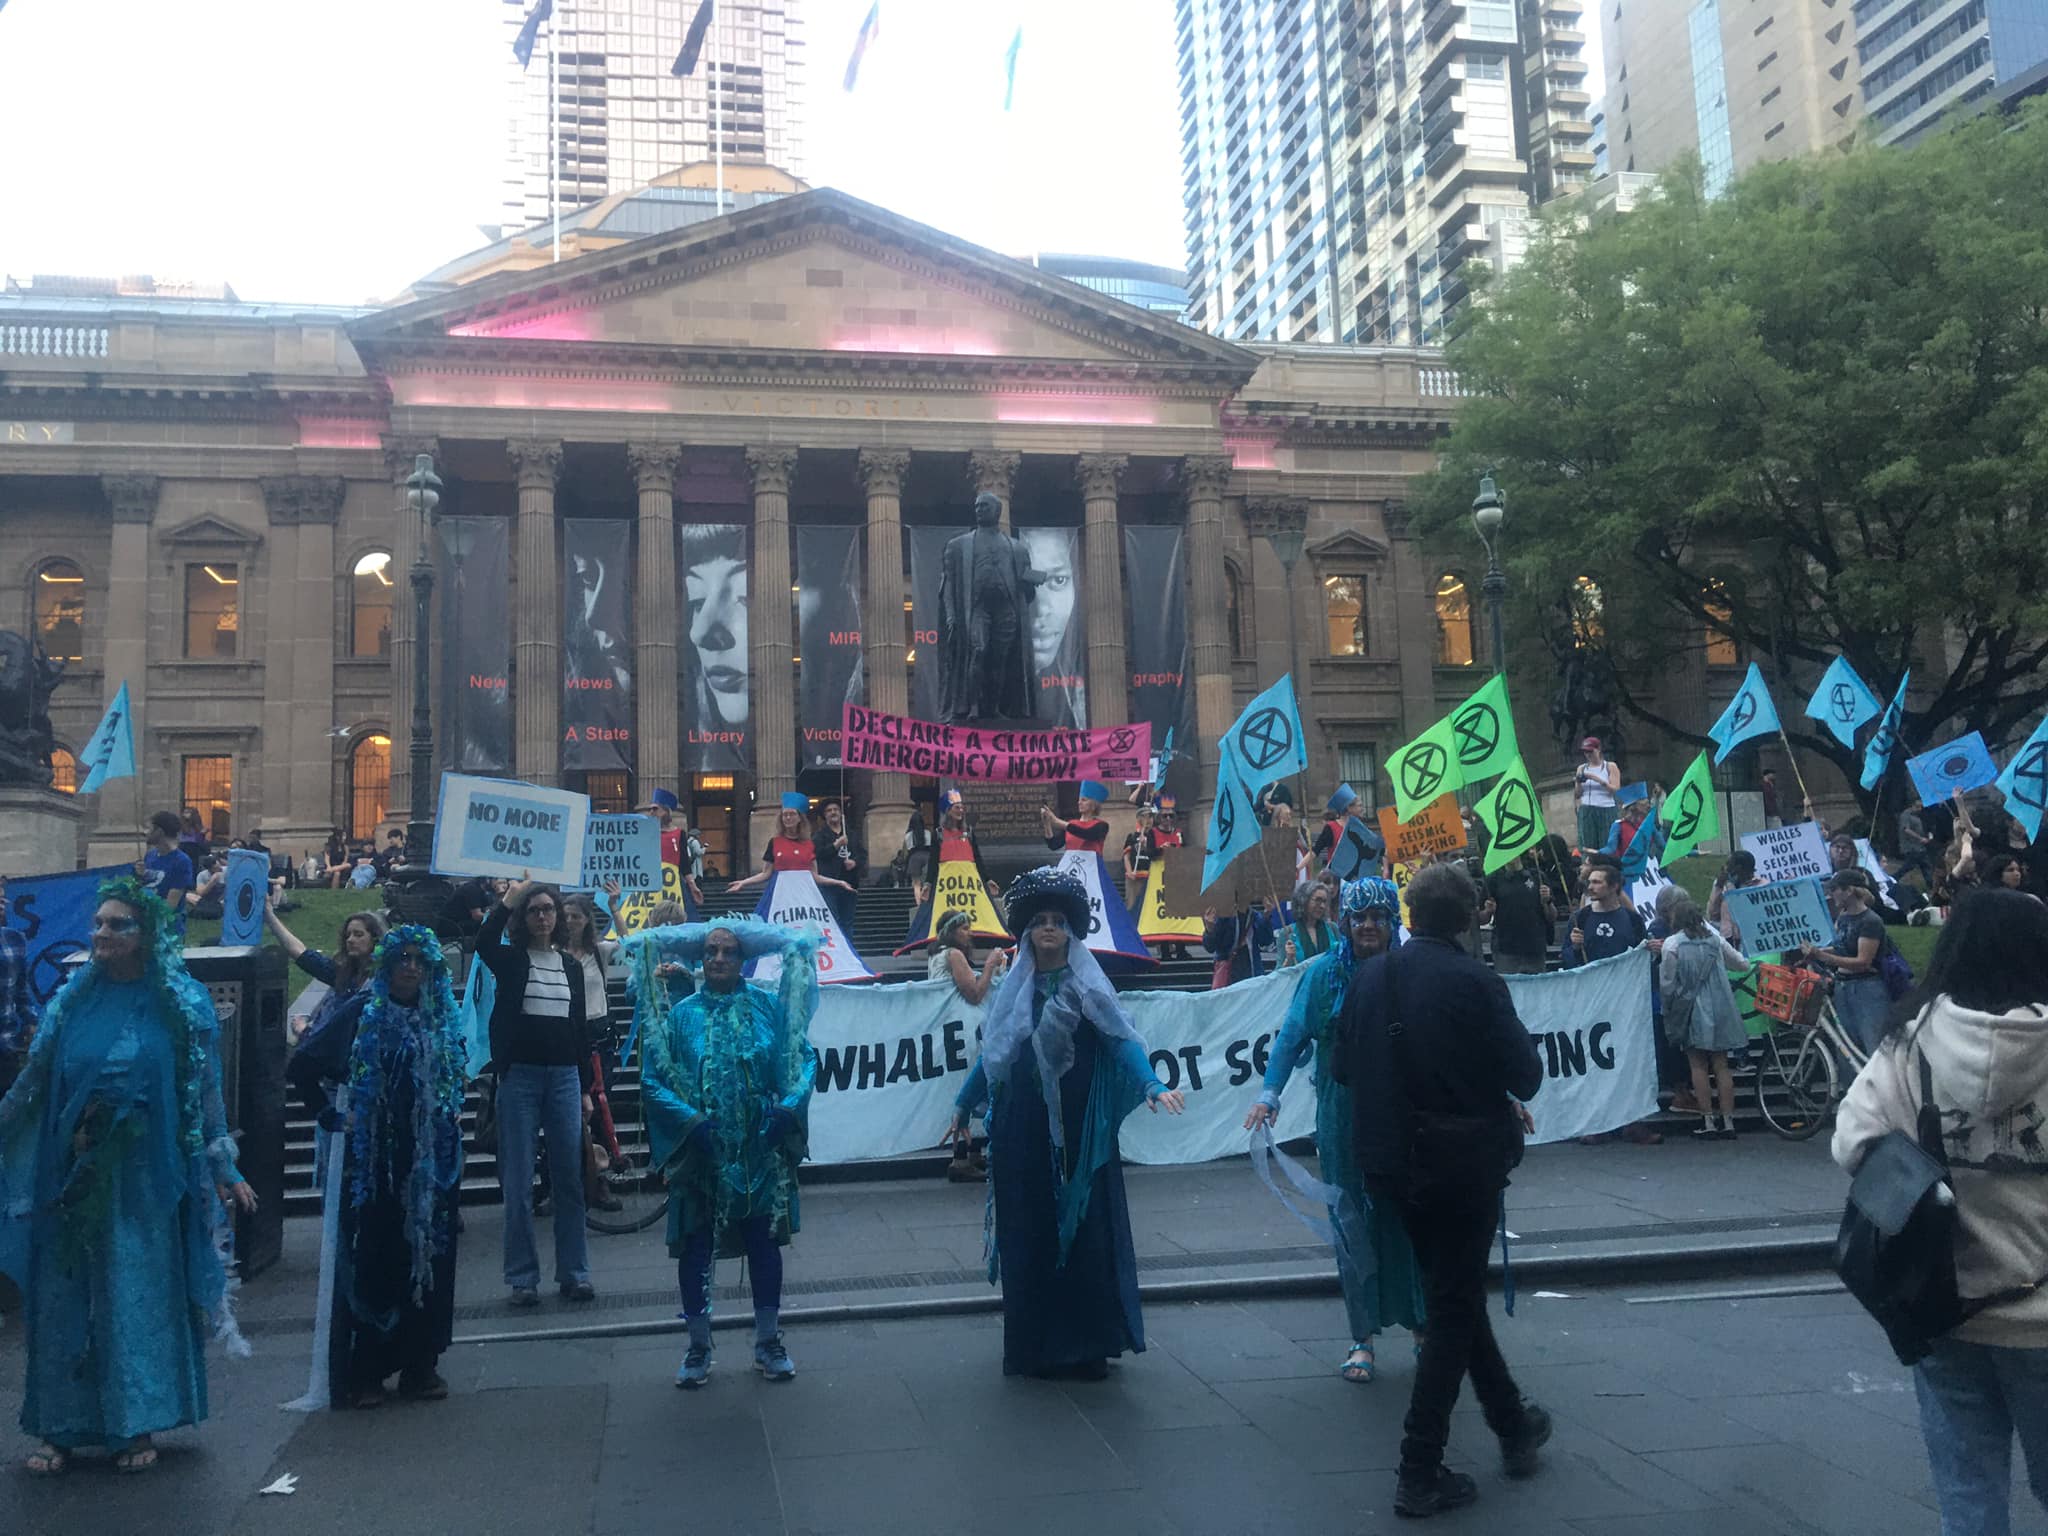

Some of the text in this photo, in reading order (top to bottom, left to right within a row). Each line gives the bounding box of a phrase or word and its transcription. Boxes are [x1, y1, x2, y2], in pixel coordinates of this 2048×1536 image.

[712, 394, 929, 418] VICTORIA
[829, 631, 862, 645] MIR
[914, 630, 938, 645] RO
[470, 674, 507, 689] New
[566, 676, 613, 690] views
[1041, 674, 1084, 689] photo
[1133, 671, 1184, 688] graphy
[565, 726, 630, 741] A State
[688, 729, 745, 746] Library
[803, 727, 842, 742] Victo
[849, 707, 1092, 753] DECLARE A CLIMATE
[847, 736, 1078, 779] EMERGENCY NOW!
[468, 801, 561, 832] NO MORE
[1399, 822, 1447, 844] SEISMIC
[1756, 826, 1802, 846] WHALES
[492, 834, 533, 857] GAS
[595, 838, 625, 853] NOT
[1771, 841, 1794, 856] NOT
[1763, 851, 1811, 870] SEISMIC
[583, 872, 650, 889] LASTING
[946, 892, 977, 907] NOT
[1746, 885, 1798, 905] WHALES
[773, 906, 830, 925] CLIMATE
[1764, 902, 1790, 918] NOT
[1757, 914, 1810, 936] SEISMIC
[1755, 928, 1821, 952] BLASTING
[813, 1020, 983, 1093] WHALE
[1148, 1045, 1204, 1091] OT
